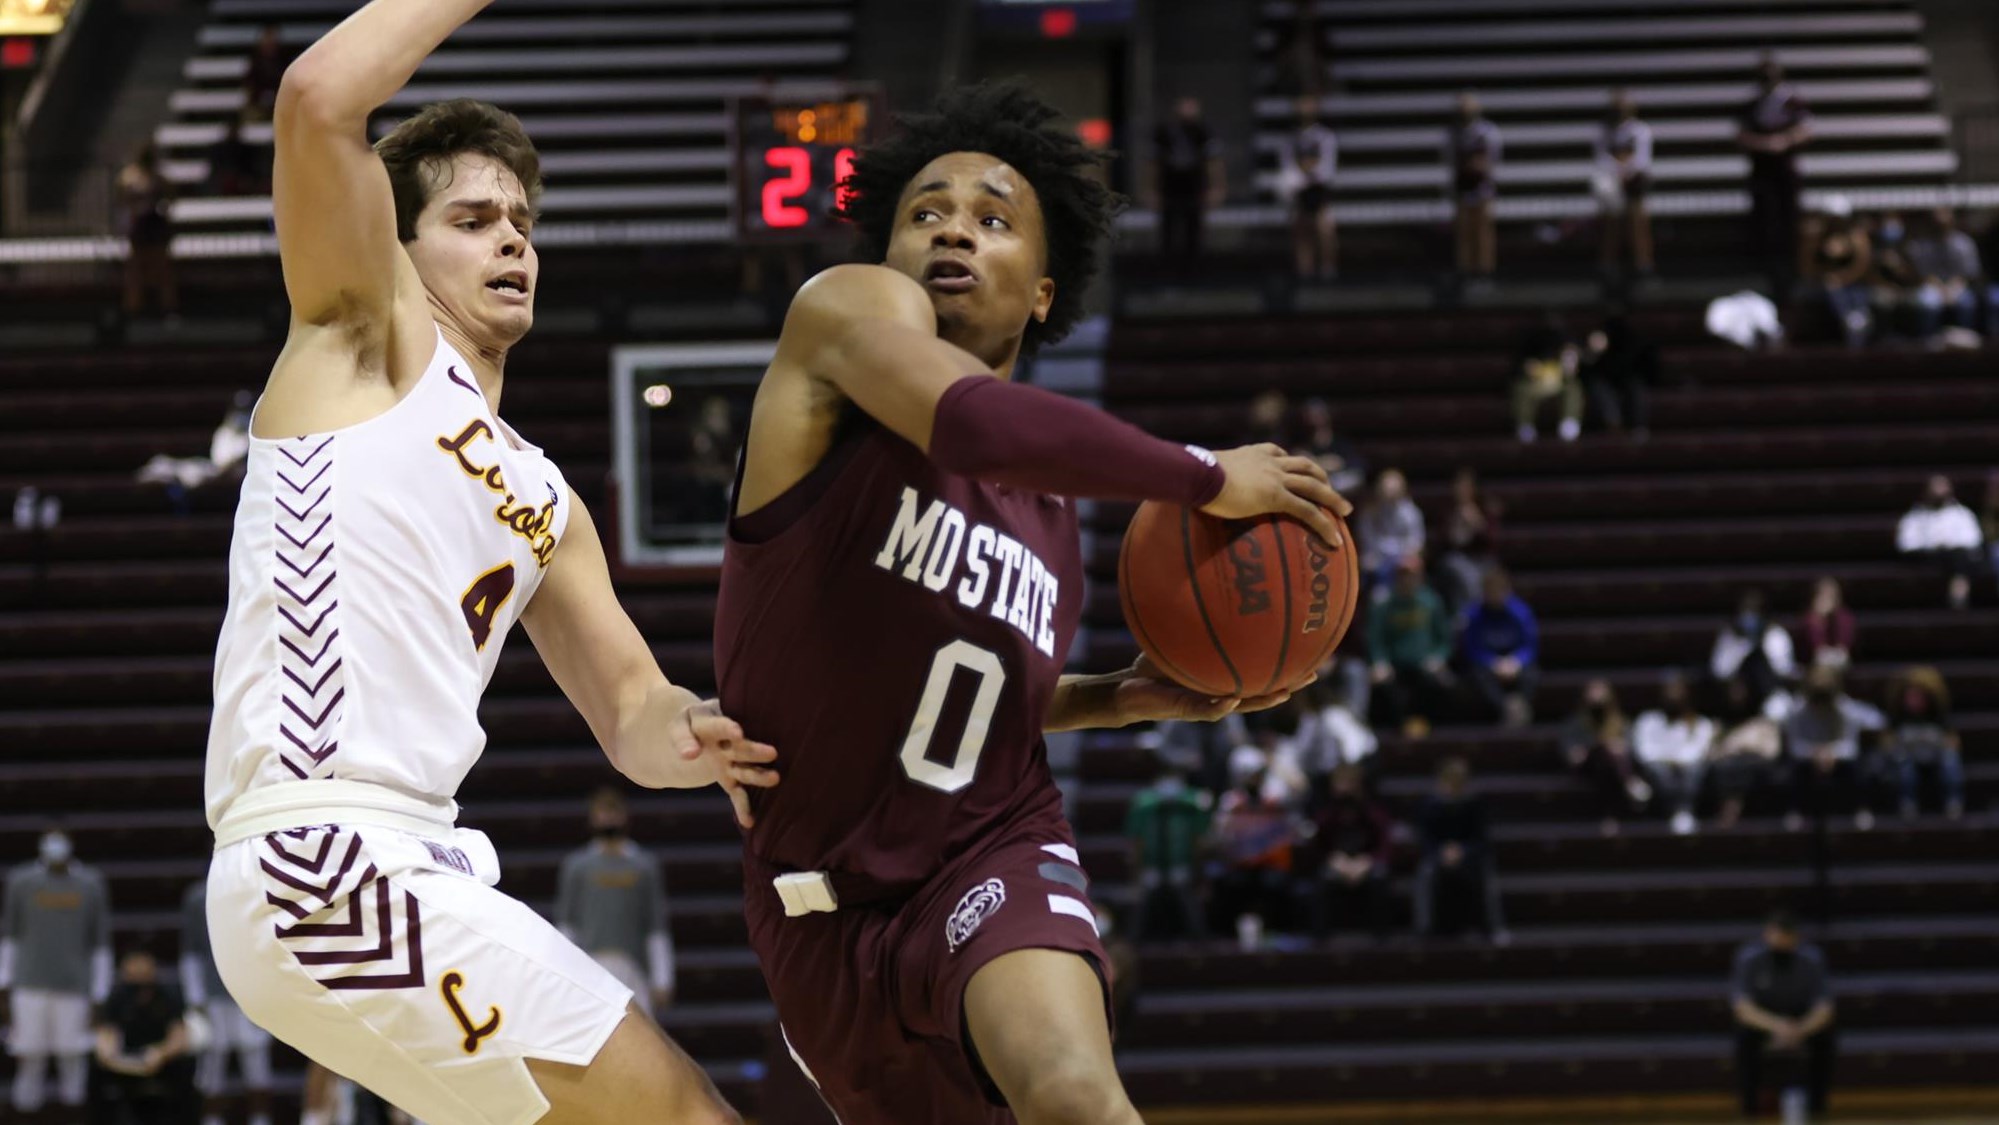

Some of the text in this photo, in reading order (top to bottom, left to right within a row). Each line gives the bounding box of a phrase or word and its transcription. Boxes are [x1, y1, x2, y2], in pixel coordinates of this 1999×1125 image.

[459, 559, 516, 654] 4
[875, 485, 1059, 660] MO STATE
[1228, 532, 1272, 617] CAA
[898, 638, 1006, 794] 0
[440, 968, 502, 1054] L
